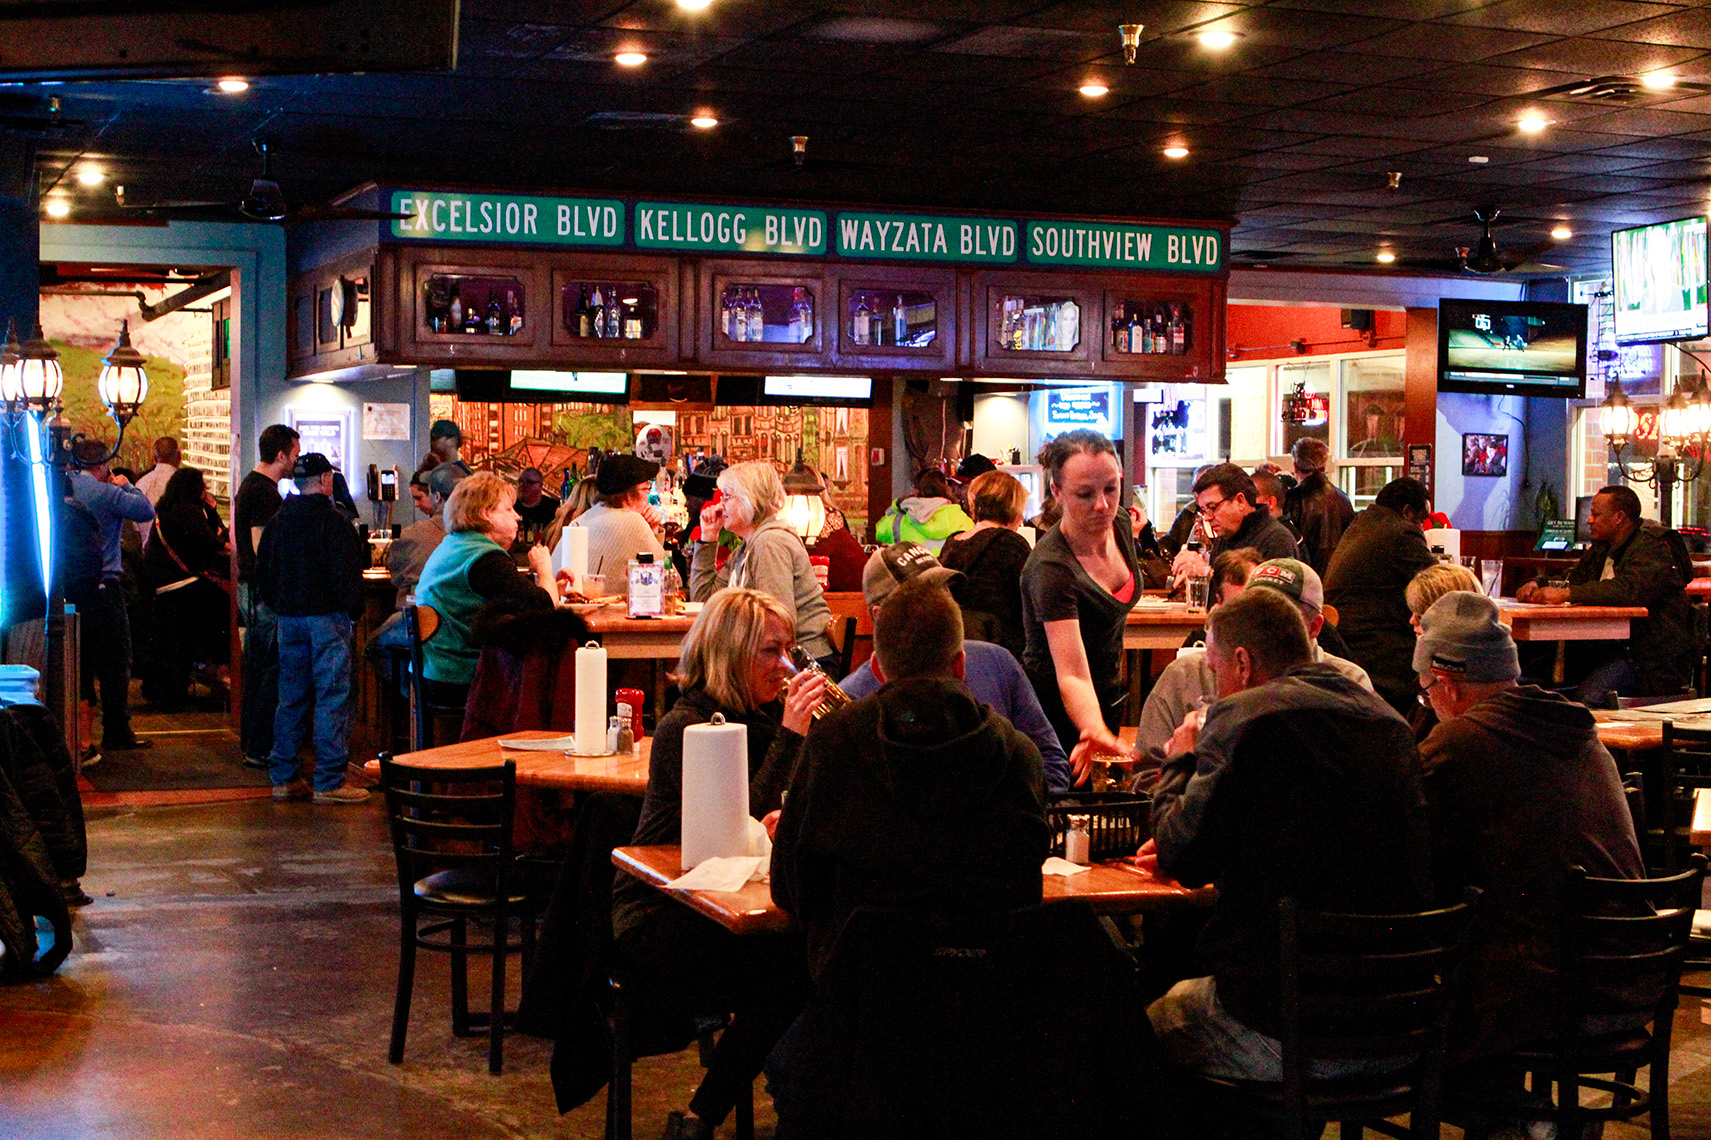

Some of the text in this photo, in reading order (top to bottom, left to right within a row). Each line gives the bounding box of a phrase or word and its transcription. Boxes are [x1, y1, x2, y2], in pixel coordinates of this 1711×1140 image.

[400, 199, 617, 238] EXCELSIOR BLVD
[640, 209, 822, 247] KELLOGG BLVD
[841, 219, 1015, 256] WAYZATA BLVD
[1032, 226, 1218, 266] SOUTHVIEW BLVD
